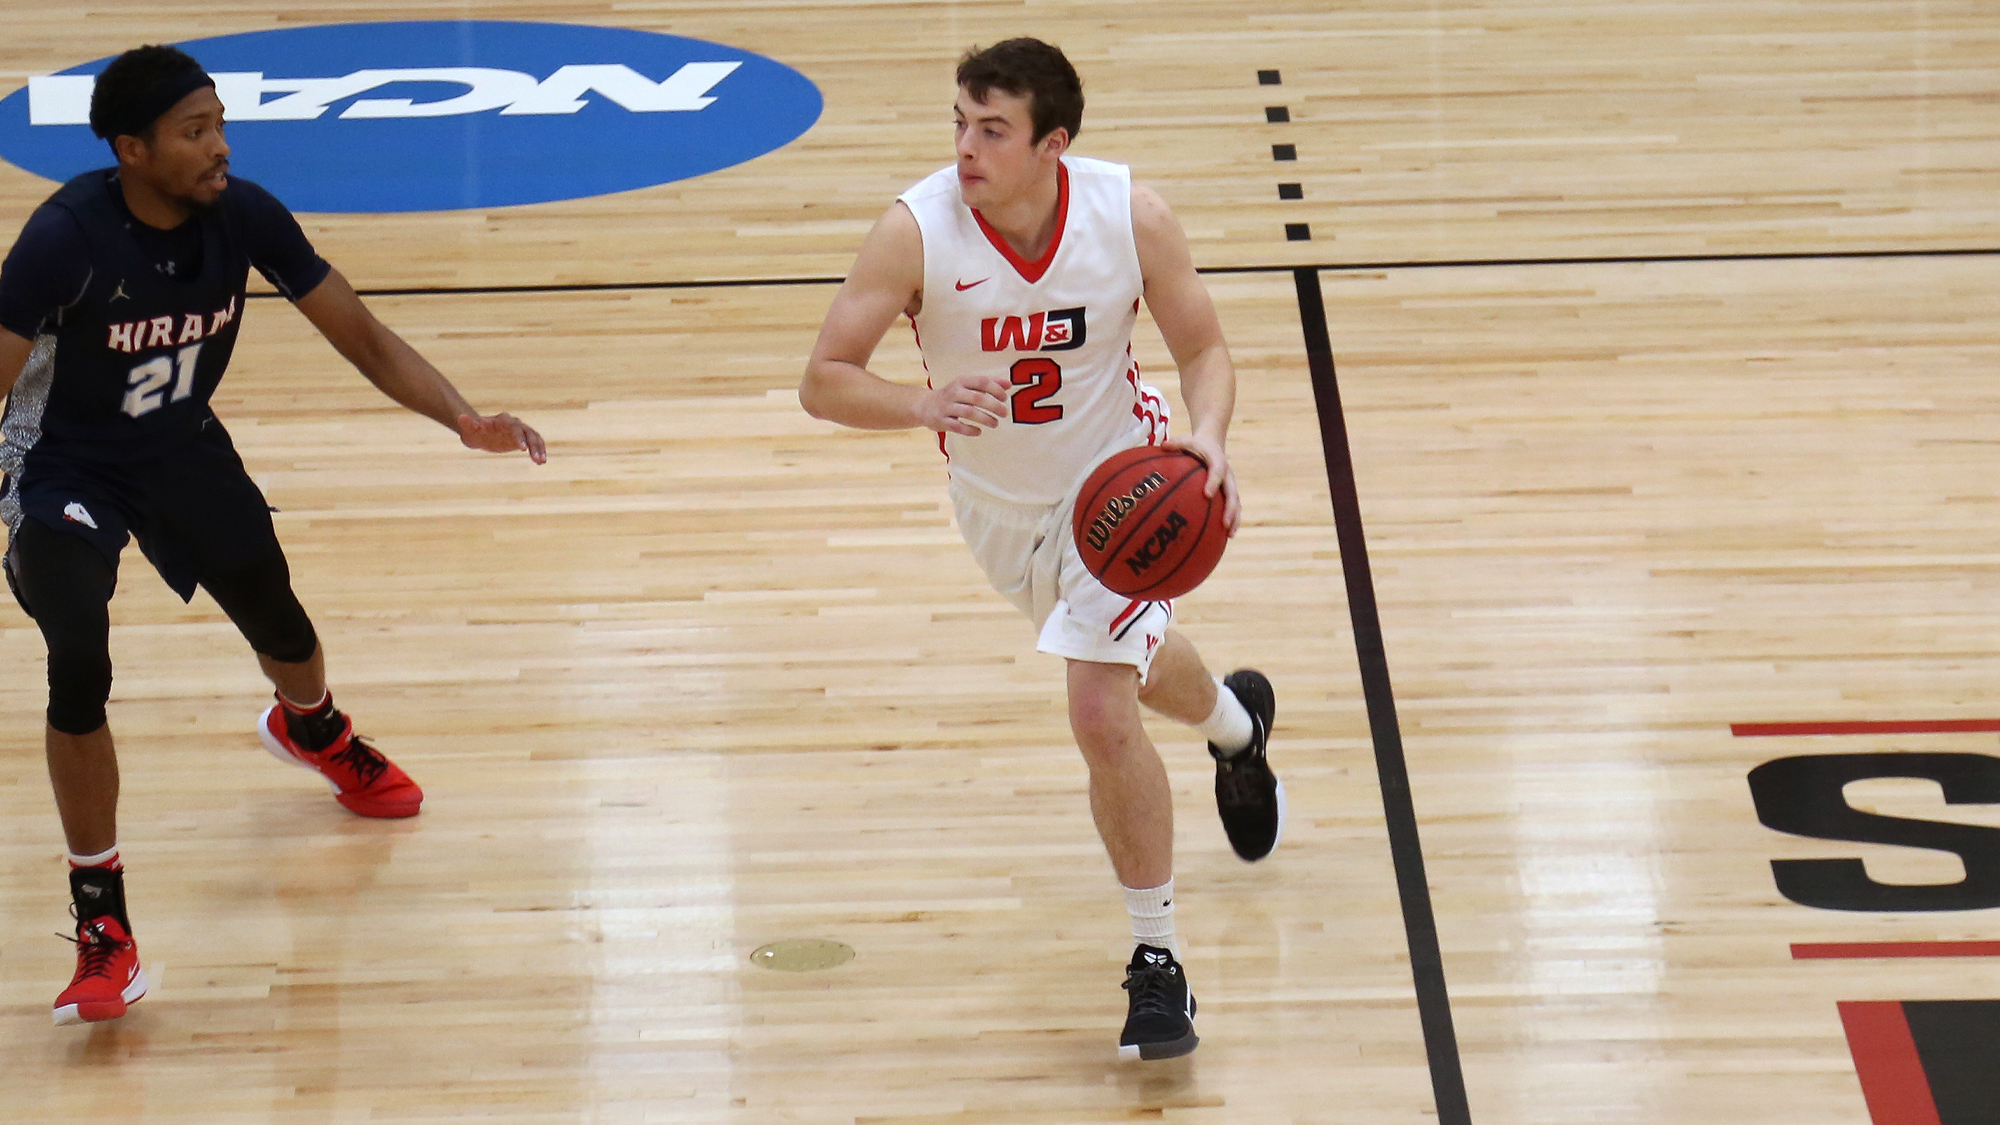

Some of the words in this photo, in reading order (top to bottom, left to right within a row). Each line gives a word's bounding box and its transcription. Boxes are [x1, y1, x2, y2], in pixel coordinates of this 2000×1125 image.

[107, 294, 236, 353] HIRAM
[980, 306, 1086, 352] W&J
[120, 342, 203, 419] 21
[1009, 358, 1063, 424] 2
[1086, 470, 1168, 553] Wilson
[1125, 509, 1190, 578] NCAA
